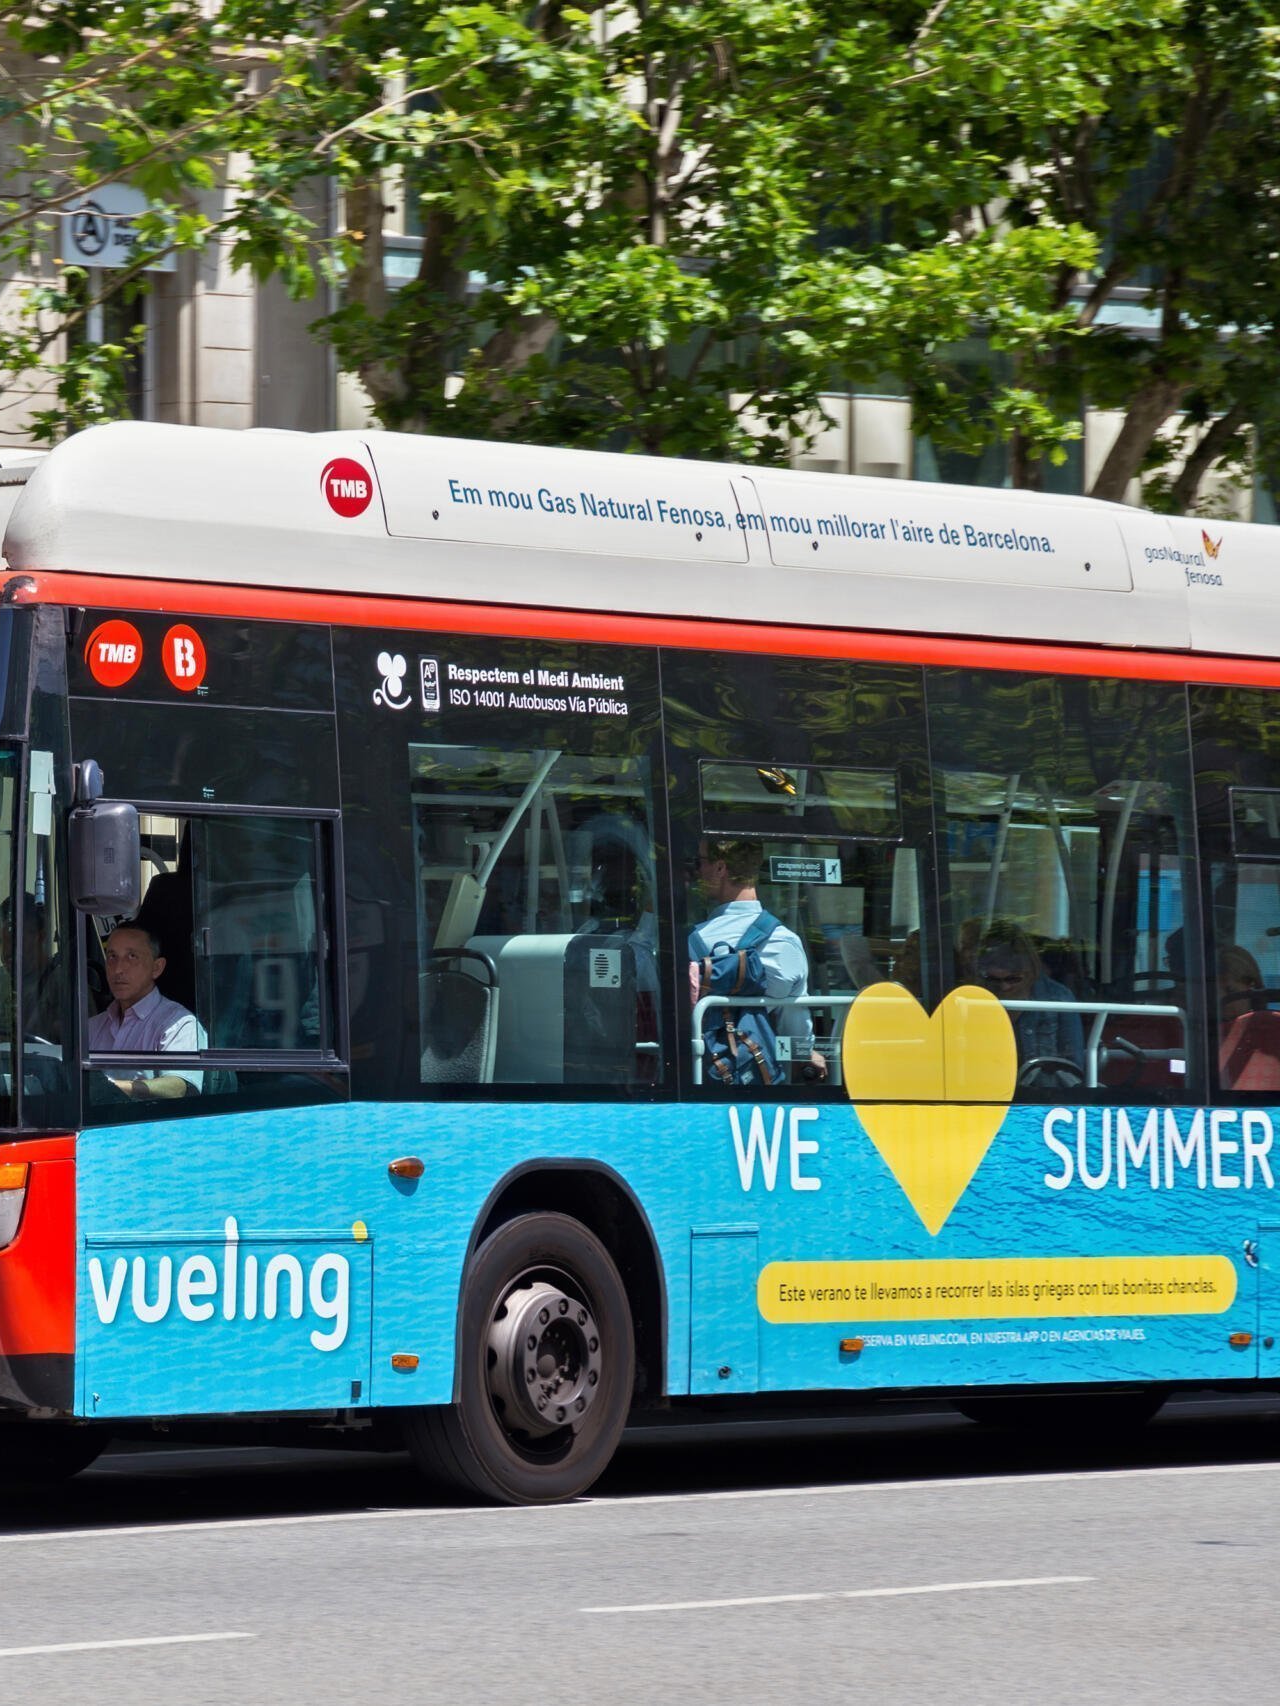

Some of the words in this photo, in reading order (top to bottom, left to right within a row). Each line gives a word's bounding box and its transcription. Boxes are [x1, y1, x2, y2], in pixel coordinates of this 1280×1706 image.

[329, 478, 368, 500] TMB
[448, 479, 482, 505] Em
[488, 487, 534, 511] mou
[538, 488, 578, 516] Gas
[580, 492, 654, 523] Natural
[656, 499, 732, 531] Fenosa,
[735, 513, 767, 532] em
[770, 514, 813, 535] mou
[817, 513, 886, 540] millorar
[890, 518, 935, 544] l'aire
[938, 521, 961, 546] de
[964, 524, 1057, 554] Barcelona.
[1184, 567, 1223, 587] fenosa
[98, 643, 137, 664] TMB
[173, 637, 197, 677] B
[447, 664, 520, 685] Respectem
[523, 669, 536, 685] el
[538, 670, 569, 688] Medi
[572, 672, 625, 691] Ambient
[449, 689, 471, 706] ISO
[473, 690, 506, 708] 14001
[508, 694, 568, 712] Autobusos
[568, 696, 587, 713] Vía
[588, 697, 629, 715] Pública
[728, 1105, 822, 1192] WE
[1042, 1107, 1276, 1191] SUMMER
[87, 1215, 350, 1351] vueling
[778, 1283, 806, 1303] Este
[809, 1287, 852, 1302] verano
[855, 1285, 868, 1301] te
[870, 1282, 923, 1301] llevamos
[926, 1286, 933, 1300] a
[935, 1285, 985, 1299] recorrer
[987, 1280, 1003, 1298] las
[1005, 1280, 1030, 1298] islas
[1033, 1279, 1075, 1301] griegas
[1078, 1282, 1100, 1297] con
[1102, 1281, 1120, 1296] tus
[1122, 1278, 1164, 1296] bonitas
[1166, 1276, 1218, 1295] chanclas.
[894, 1334, 907, 1347] EN
[971, 1331, 983, 1345] EN
[984, 1330, 1021, 1345] NUESTRA
[1022, 1330, 1039, 1343] APP
[1040, 1330, 1049, 1342] O
[1049, 1330, 1061, 1342] EN
[1062, 1328, 1105, 1342] AGENCIAS
[1105, 1328, 1117, 1341] DE
